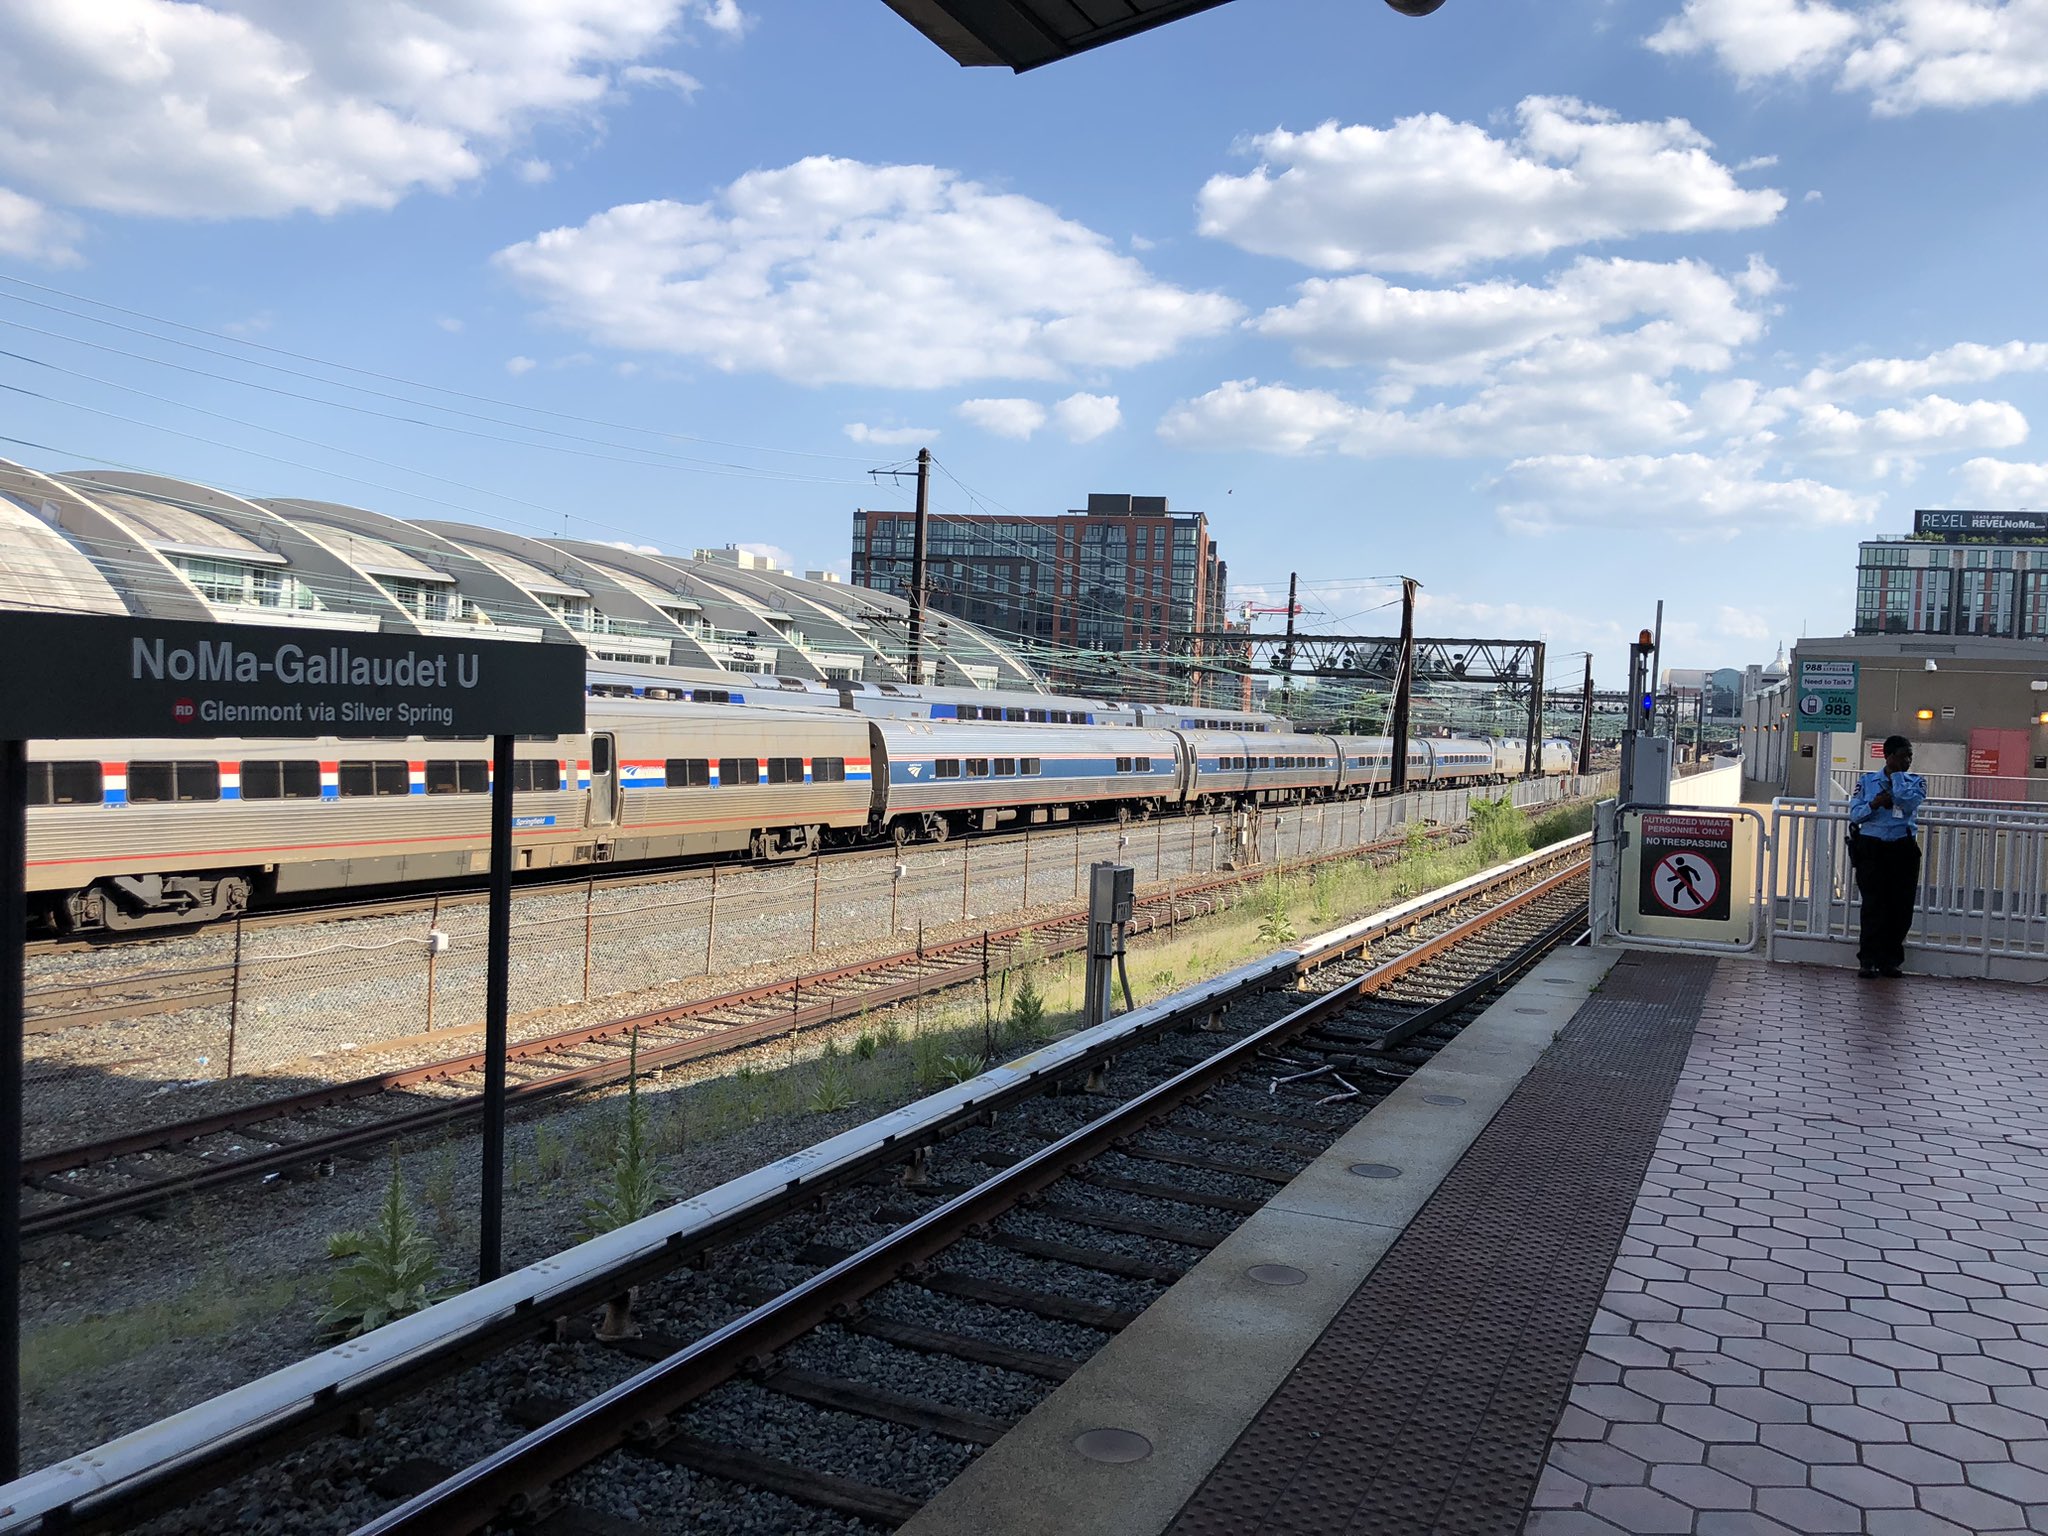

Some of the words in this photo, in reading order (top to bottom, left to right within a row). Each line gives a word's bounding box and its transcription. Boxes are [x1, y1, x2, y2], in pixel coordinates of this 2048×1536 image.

[1922, 514, 1967, 527] REVEL
[132, 637, 447, 688] NoMa-Gallaudet
[457, 653, 479, 689] U
[175, 705, 194, 716] RD
[200, 699, 303, 722] Glenmont
[308, 701, 336, 722] via
[341, 702, 394, 722] Silver
[397, 702, 453, 726] Spring
[1825, 704, 1851, 716] 988
[1643, 817, 1697, 826] AUTHORIZED
[1648, 825, 1700, 834] PERSONNEL
[1646, 837, 1660, 845] NO
[1662, 838, 1727, 848] TRESPASSING
